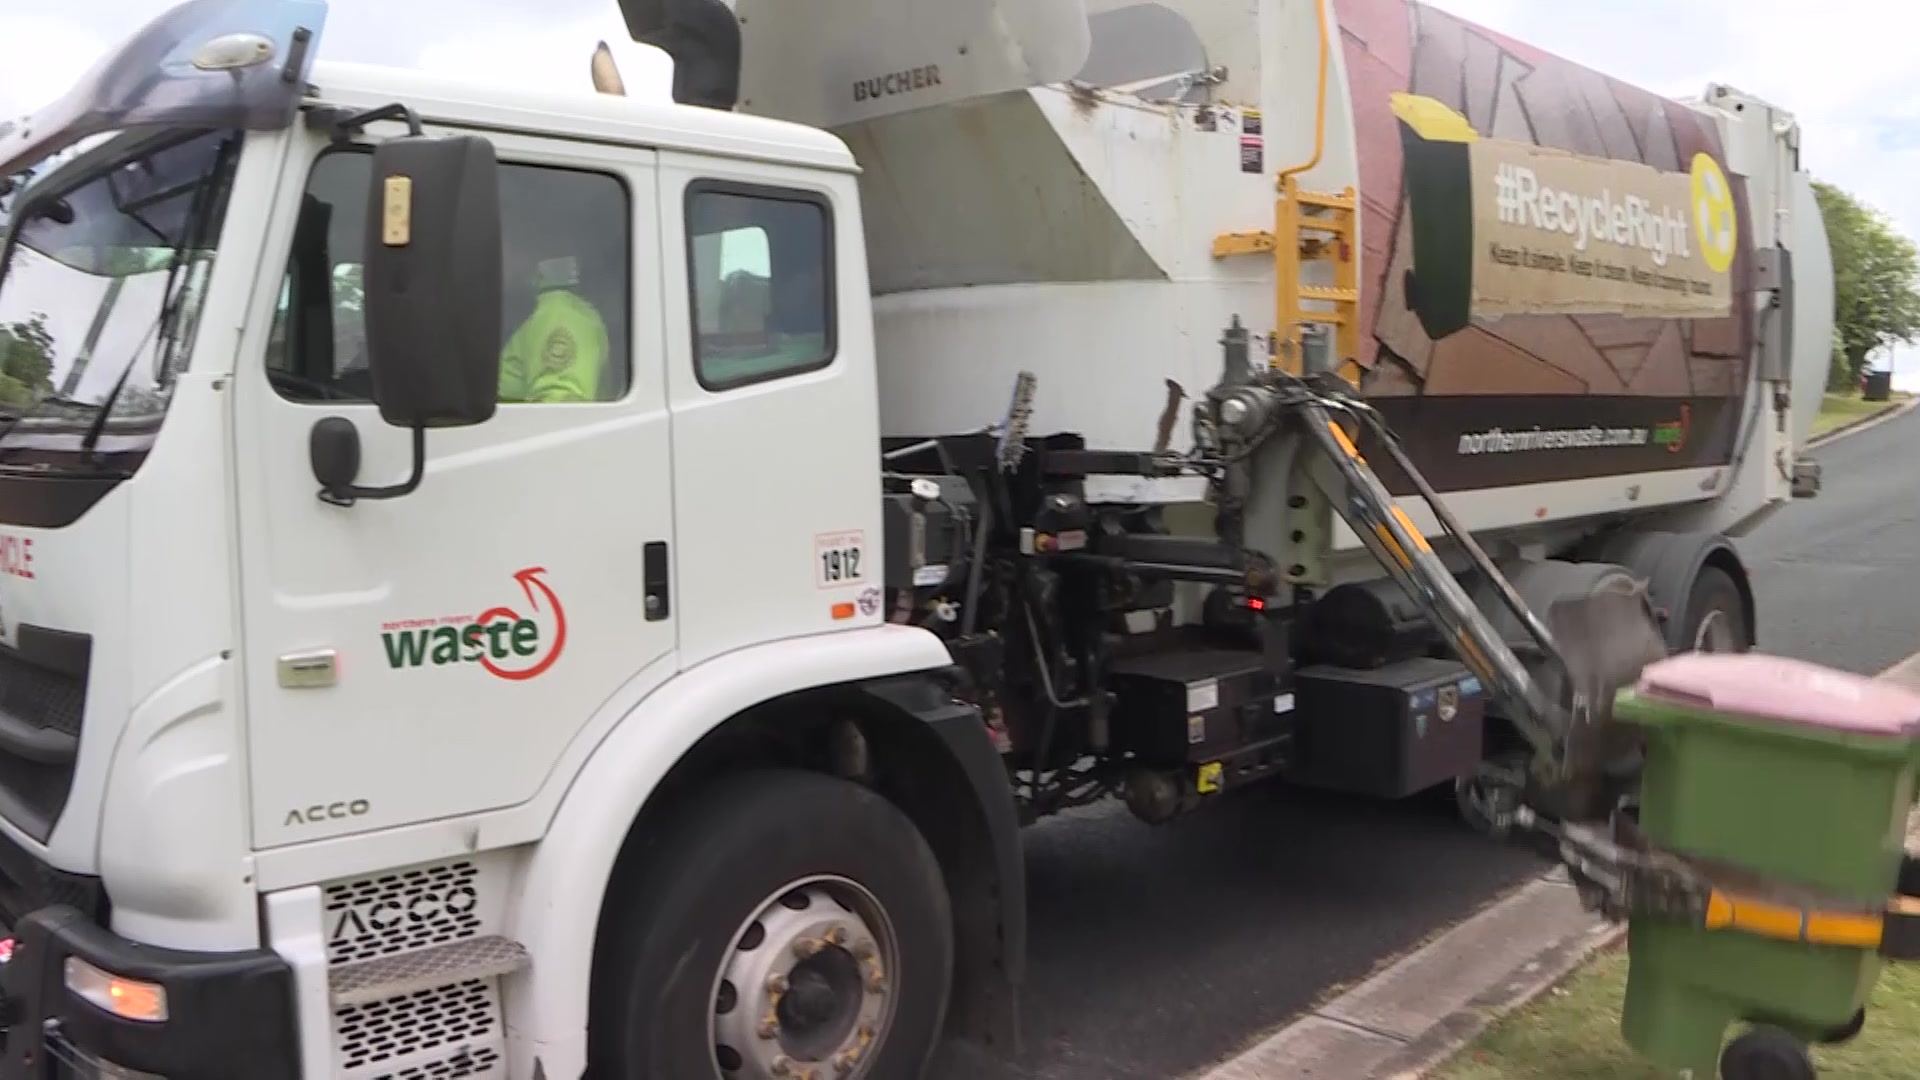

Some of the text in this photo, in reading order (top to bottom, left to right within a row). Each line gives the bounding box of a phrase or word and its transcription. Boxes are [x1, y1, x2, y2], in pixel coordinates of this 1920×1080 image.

[853, 64, 941, 101] BUCHER
[1494, 162, 1689, 266] #RecycleRight
[1489, 241, 1519, 271] Keep
[1458, 424, 1648, 455] northernriverswaste.com.au
[0, 534, 35, 581] ICLE
[821, 547, 862, 582] 1912
[380, 618, 539, 669] waste
[283, 798, 370, 826] ACCO
[332, 886, 477, 939] ACCO
